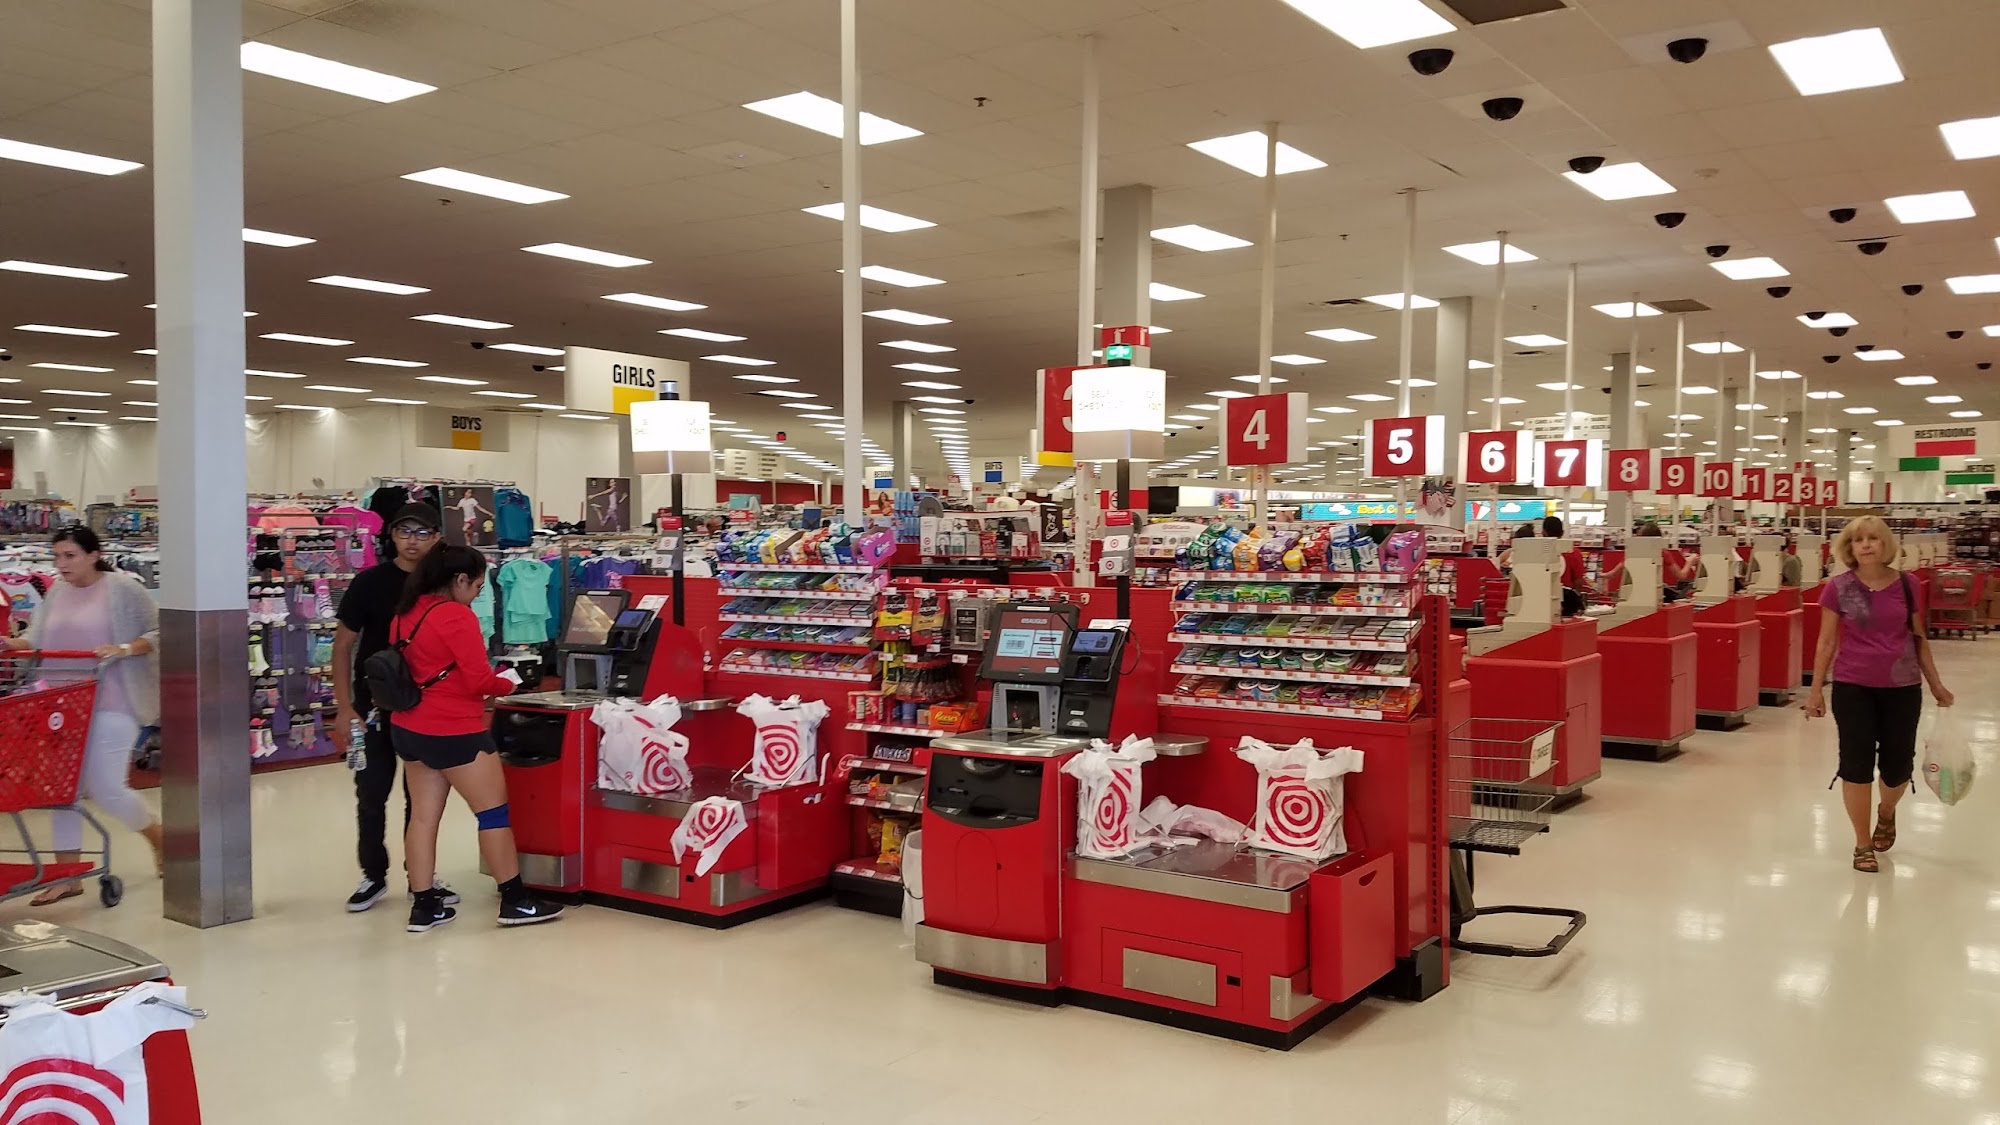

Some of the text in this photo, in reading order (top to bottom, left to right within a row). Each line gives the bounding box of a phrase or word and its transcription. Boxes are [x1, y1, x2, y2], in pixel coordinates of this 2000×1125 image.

[613, 364, 656, 388] GIRLS
[451, 415, 482, 431] BOYS
[1242, 409, 1270, 450] 4
[1914, 427, 1976, 439] RESTROOMS
[1387, 428, 1414, 465] 5
[1480, 441, 1505, 473] 6
[1554, 448, 1580, 478] 7
[1619, 457, 1640, 483] 8
[1666, 464, 1685, 487] 9
[1703, 468, 1730, 491] 10
[1741, 474, 1759, 494] 11
[1775, 478, 1791, 497] 2
[1801, 482, 1814, 499] 3
[1822, 485, 1836, 501] 4
